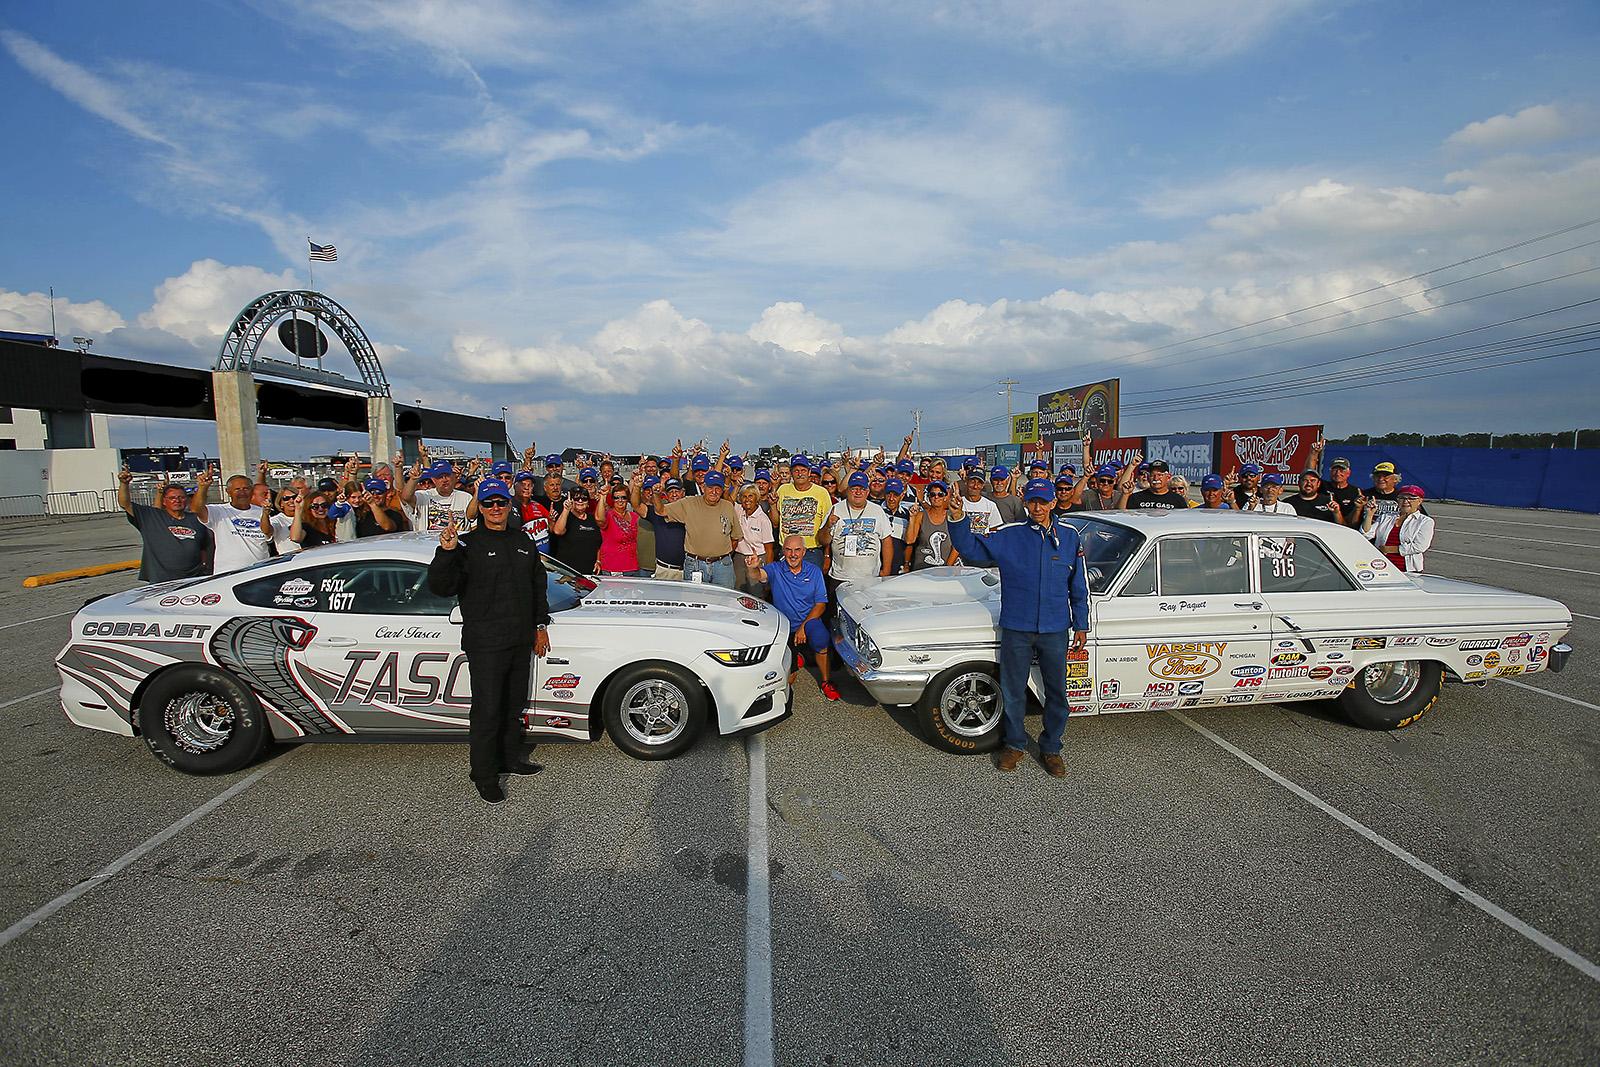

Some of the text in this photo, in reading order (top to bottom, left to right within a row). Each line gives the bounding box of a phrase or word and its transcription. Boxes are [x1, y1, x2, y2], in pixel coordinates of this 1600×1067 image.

[1038, 408, 1083, 424] Brownsburg
[1147, 444, 1211, 464] DRAGSTER
[1272, 558, 1295, 578] 315
[320, 579, 346, 593] FS/XX
[328, 592, 356, 611] 1677
[1159, 602, 1177, 612] Ray
[82, 622, 212, 639] COBRA JET
[374, 625, 442, 639] Carl Tasca
[1145, 642, 1228, 659] VARSITY
[1460, 640, 1498, 649] MOROSO
[1278, 653, 1300, 661] RAM
[1161, 656, 1208, 677] Ford
[1232, 667, 1264, 675] manton
[1269, 667, 1308, 679] Autolite
[331, 650, 472, 707] TASC
[1147, 682, 1175, 692] MSD
[1287, 689, 1342, 698] GOODYEAR
